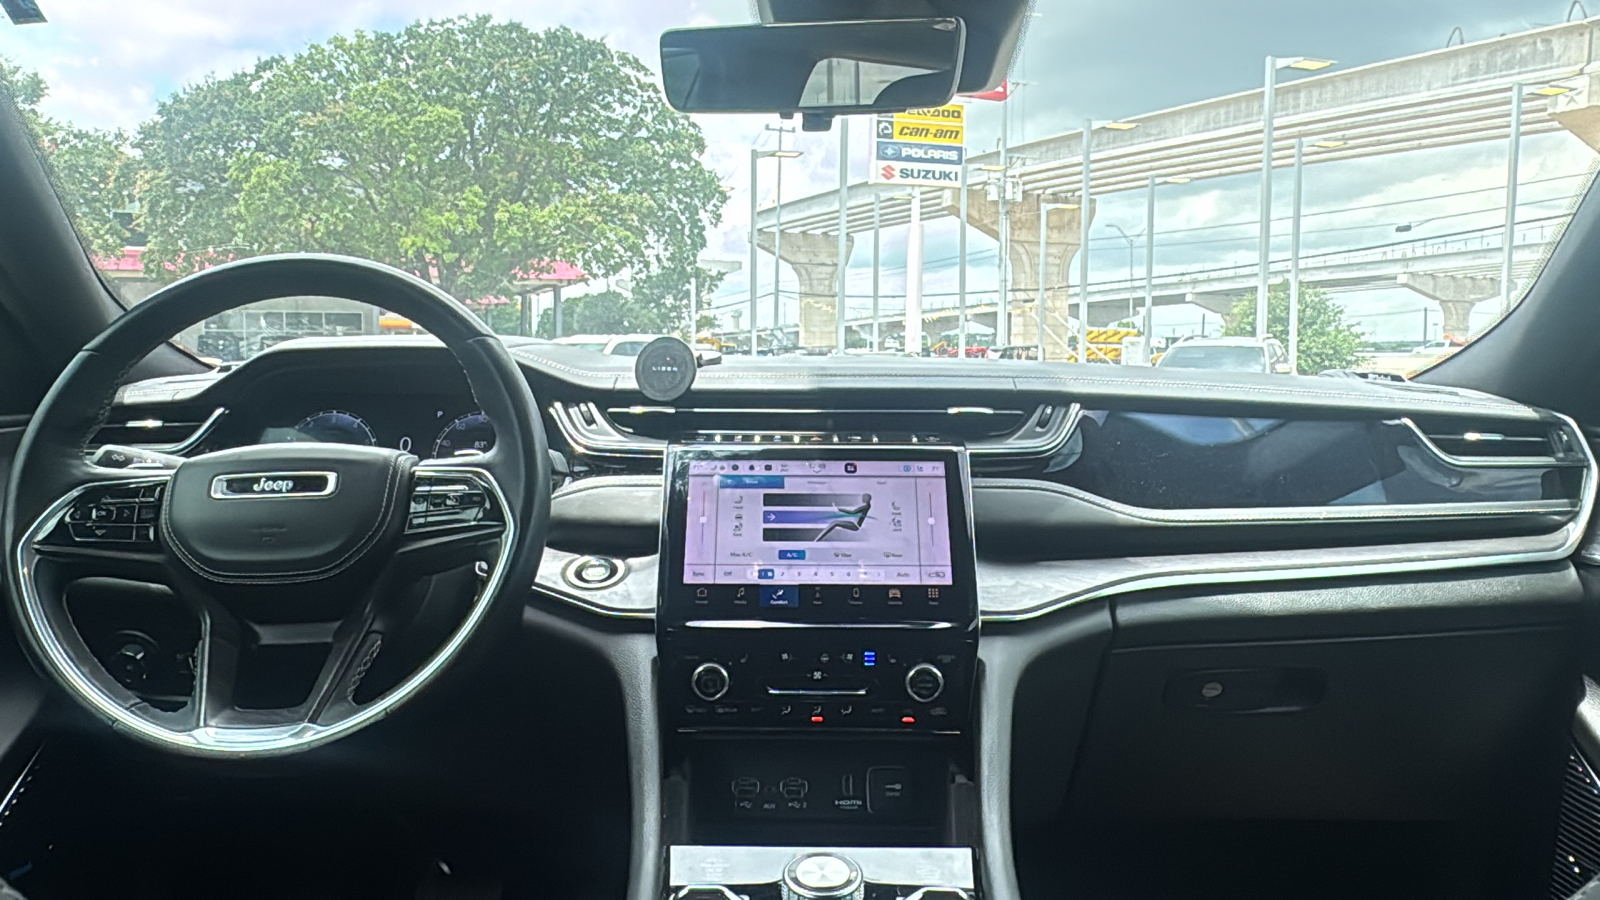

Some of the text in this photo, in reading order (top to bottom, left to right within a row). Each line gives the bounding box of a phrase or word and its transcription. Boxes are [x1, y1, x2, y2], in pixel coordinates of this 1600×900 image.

[898, 126, 960, 140] can-am
[901, 147, 959, 161] POLARIS
[899, 168, 959, 182] SUZUKI
[253, 477, 294, 493] Jeep
[786, 550, 799, 558] A/C
